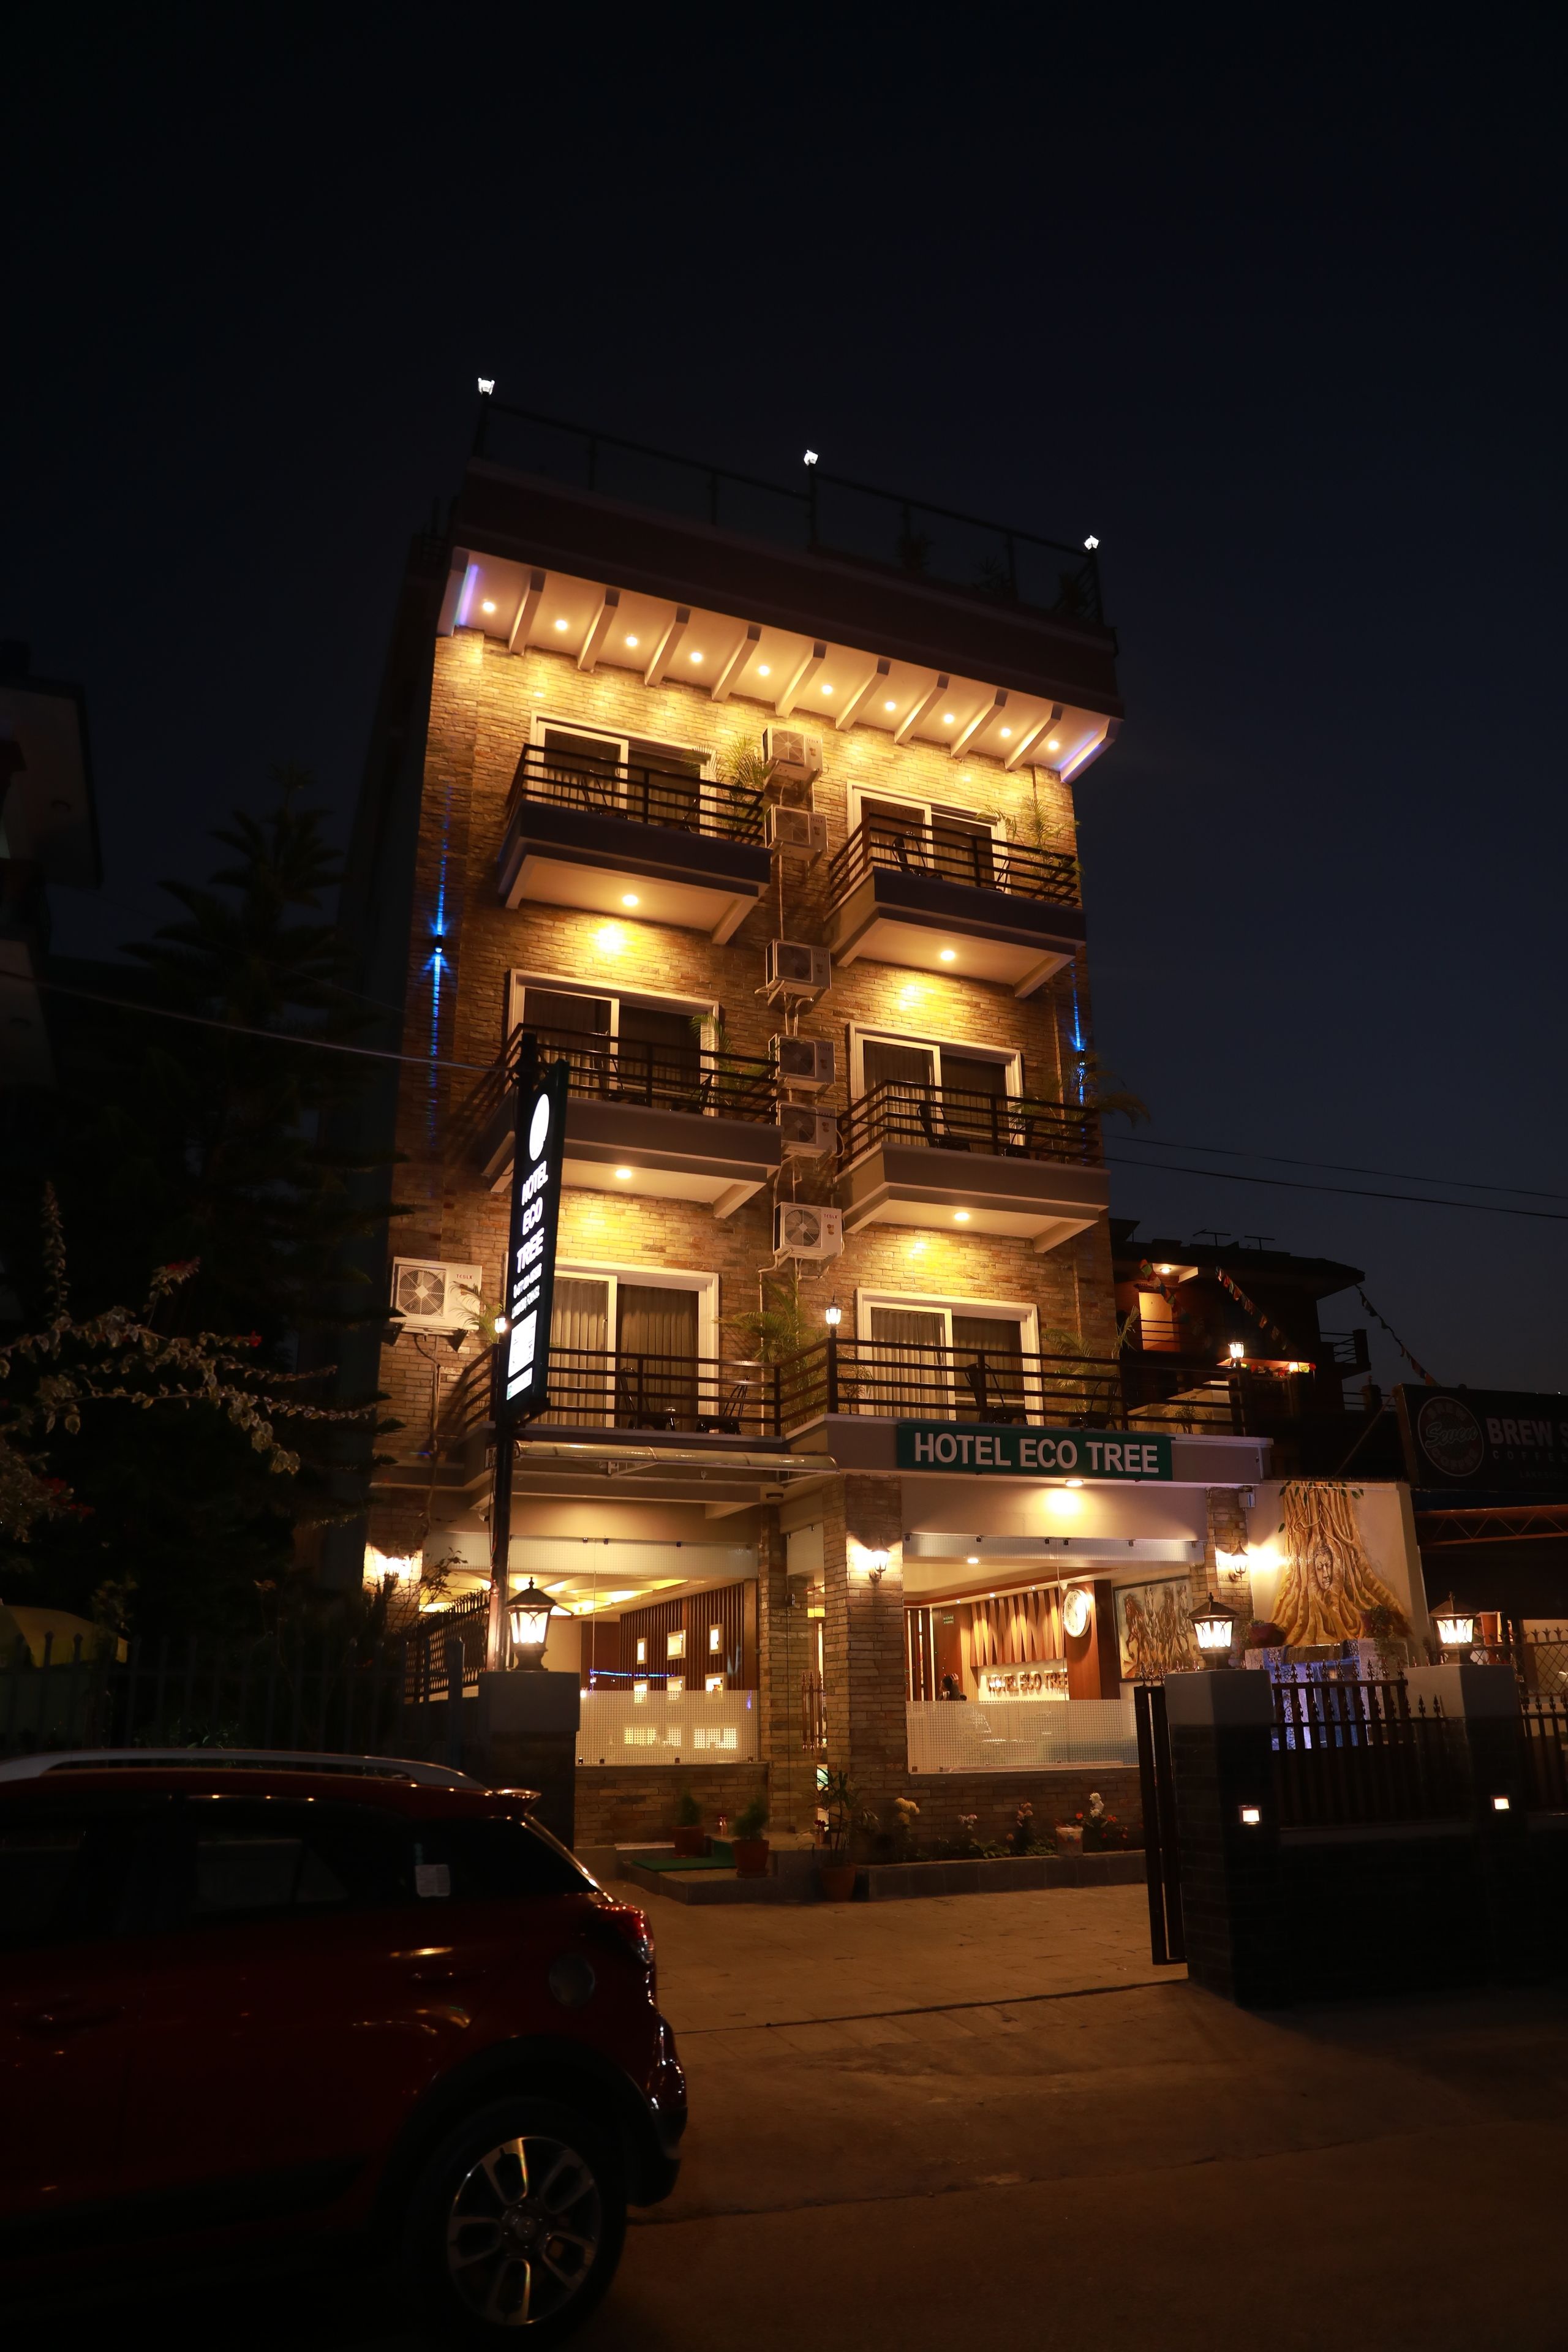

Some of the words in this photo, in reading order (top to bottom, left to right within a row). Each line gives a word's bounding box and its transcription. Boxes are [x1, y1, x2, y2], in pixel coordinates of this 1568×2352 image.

[522, 1160, 549, 1206] HOTEL
[522, 1197, 543, 1235] ECO
[517, 1227, 545, 1273] TREE
[1425, 1421, 1479, 1449] Seven
[1485, 1417, 1554, 1447] BREW
[914, 1432, 1011, 1466] HOTEL
[1019, 1438, 1077, 1469] ECO
[1085, 1441, 1159, 1473] TREE
[1492, 1449, 1568, 1463] COFFEE
